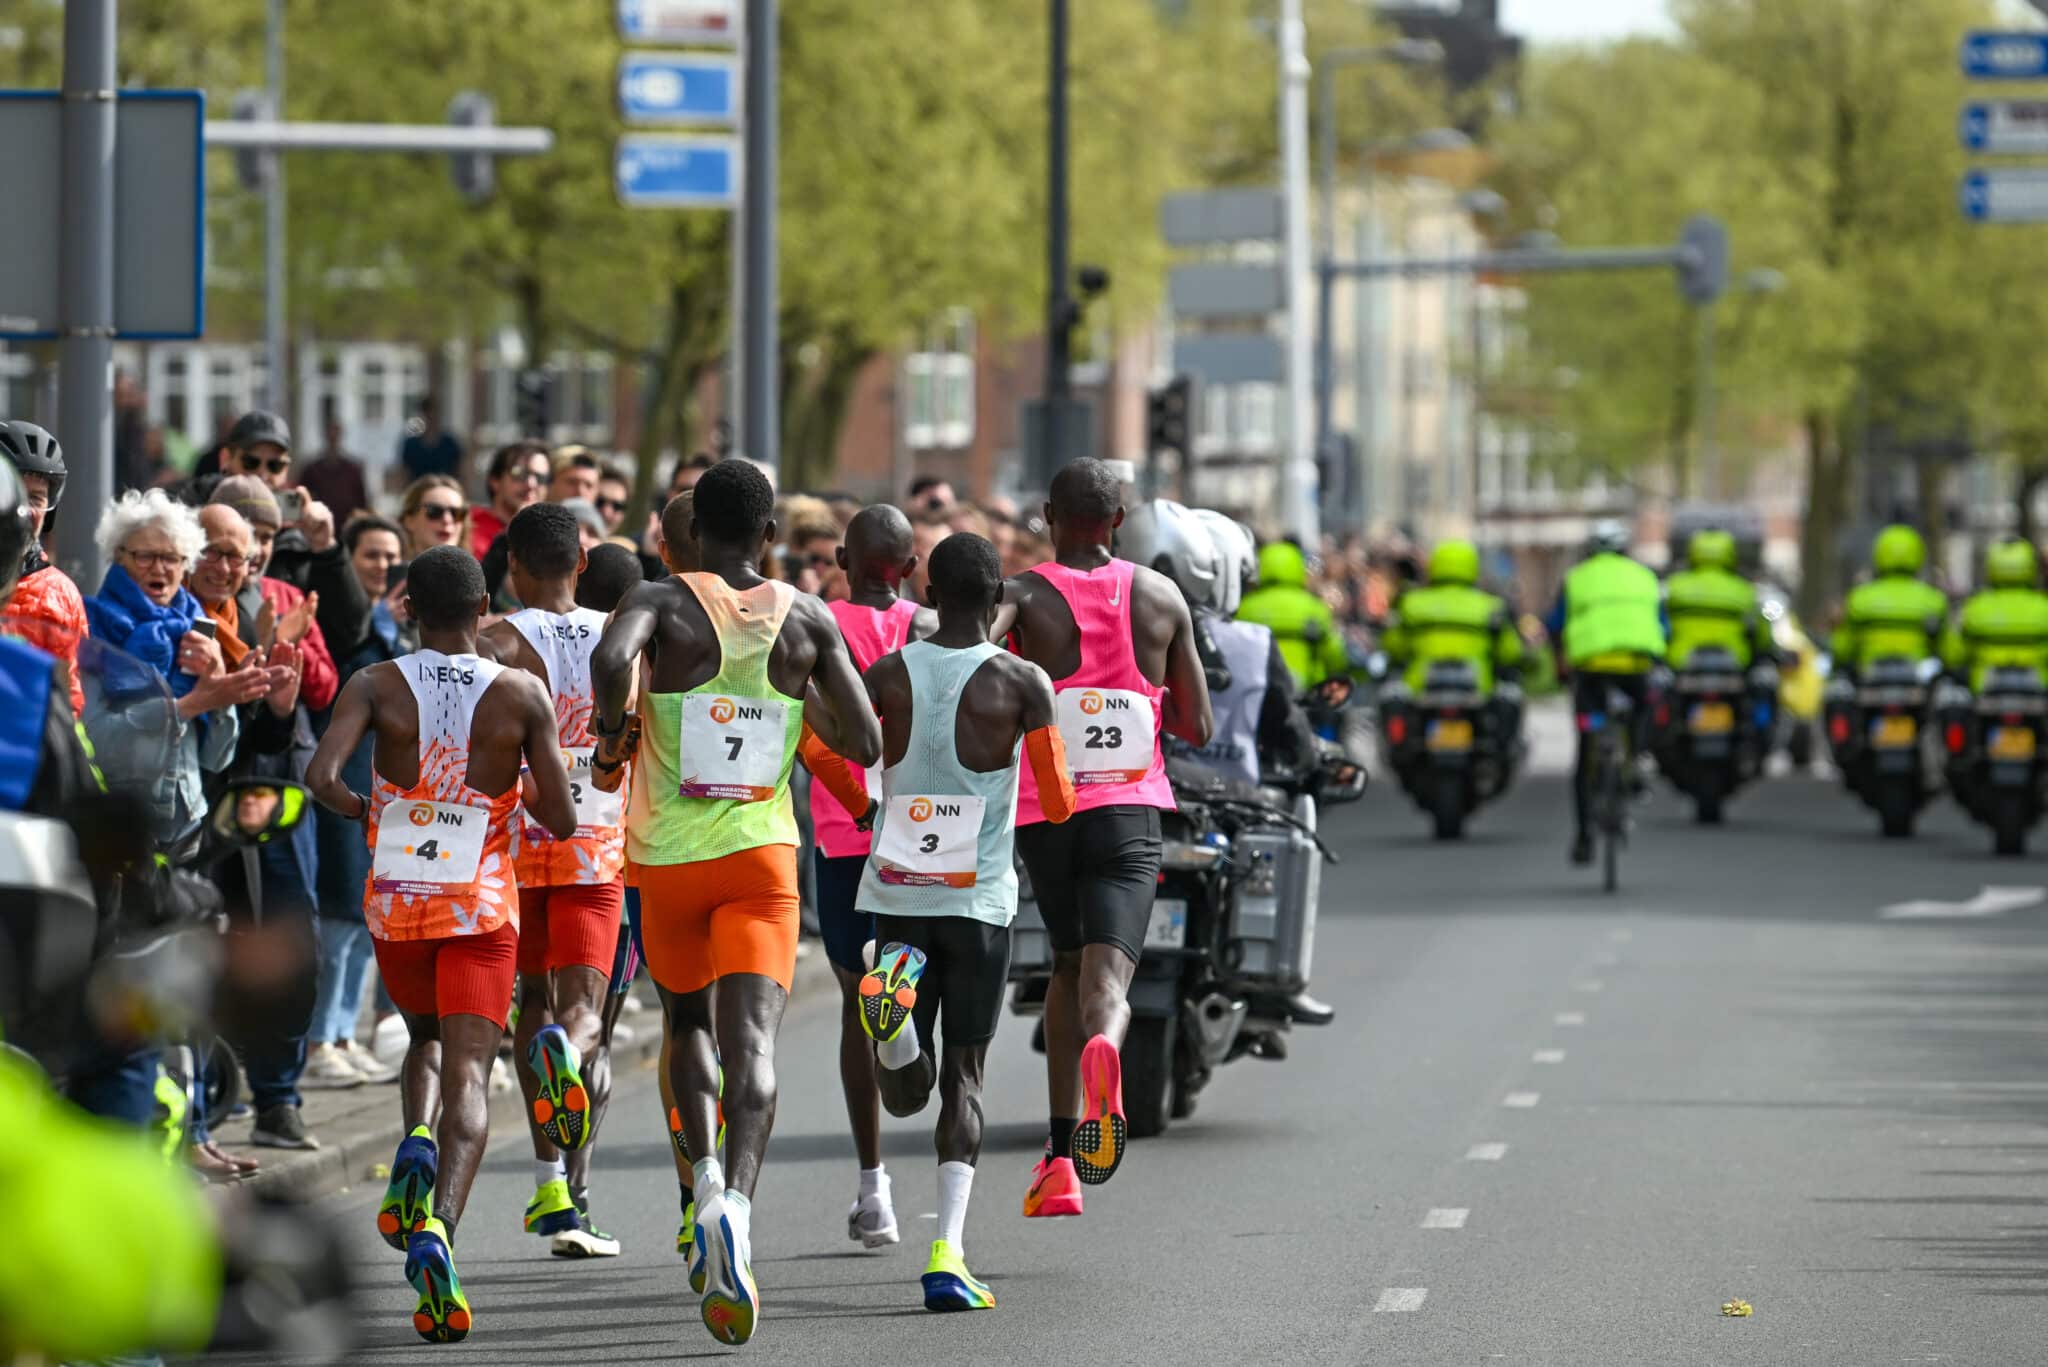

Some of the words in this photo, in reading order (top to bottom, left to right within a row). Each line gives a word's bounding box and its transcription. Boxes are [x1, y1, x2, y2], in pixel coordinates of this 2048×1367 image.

[418, 663, 475, 686] INEOS
[738, 706, 762, 720] NN
[1105, 698, 1129, 710] NN
[1085, 725, 1122, 749] 23
[725, 736, 744, 761] 7
[570, 783, 582, 804] 2
[437, 811, 463, 826] NN
[935, 804, 960, 817] NN
[416, 839, 438, 861] 4
[919, 833, 940, 853] 3
